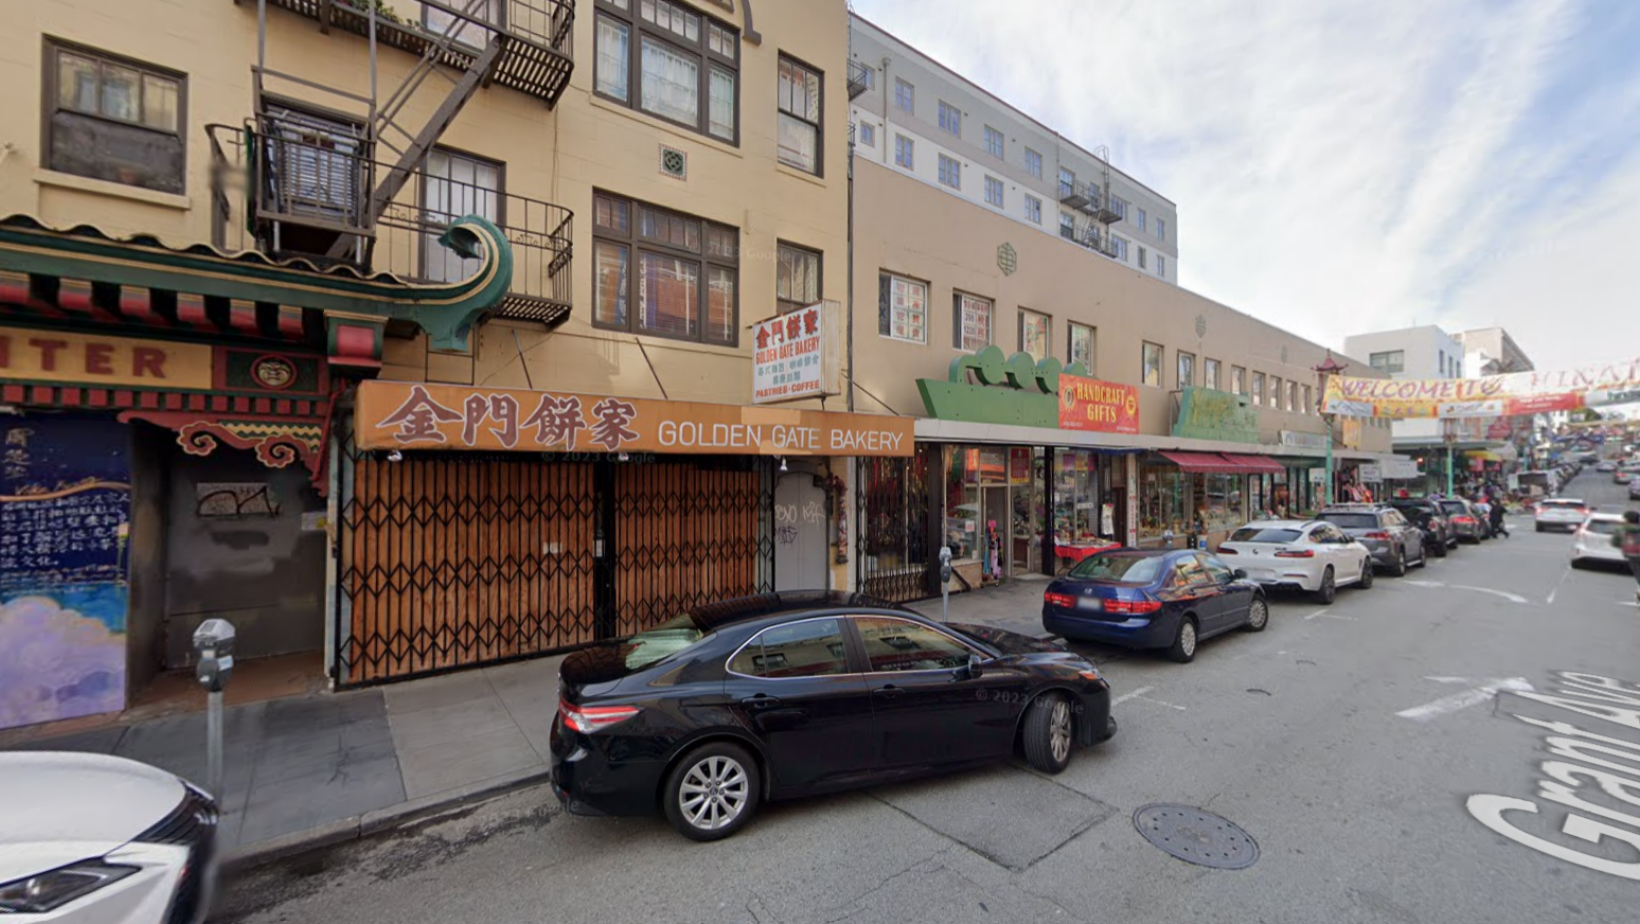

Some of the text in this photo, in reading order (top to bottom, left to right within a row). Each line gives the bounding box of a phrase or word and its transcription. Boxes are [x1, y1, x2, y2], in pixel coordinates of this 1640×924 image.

[756, 336, 820, 365] GOLDEN GATE BAKERY
[1077, 382, 1125, 406] HANDCRAFT
[1341, 379, 1453, 398] WELCOME
[1465, 376, 1504, 397] TO
[376, 385, 640, 451] 金門餅家
[1087, 403, 1117, 423] GIFTS
[658, 420, 904, 450] GOLDEN GATE BAKERY
